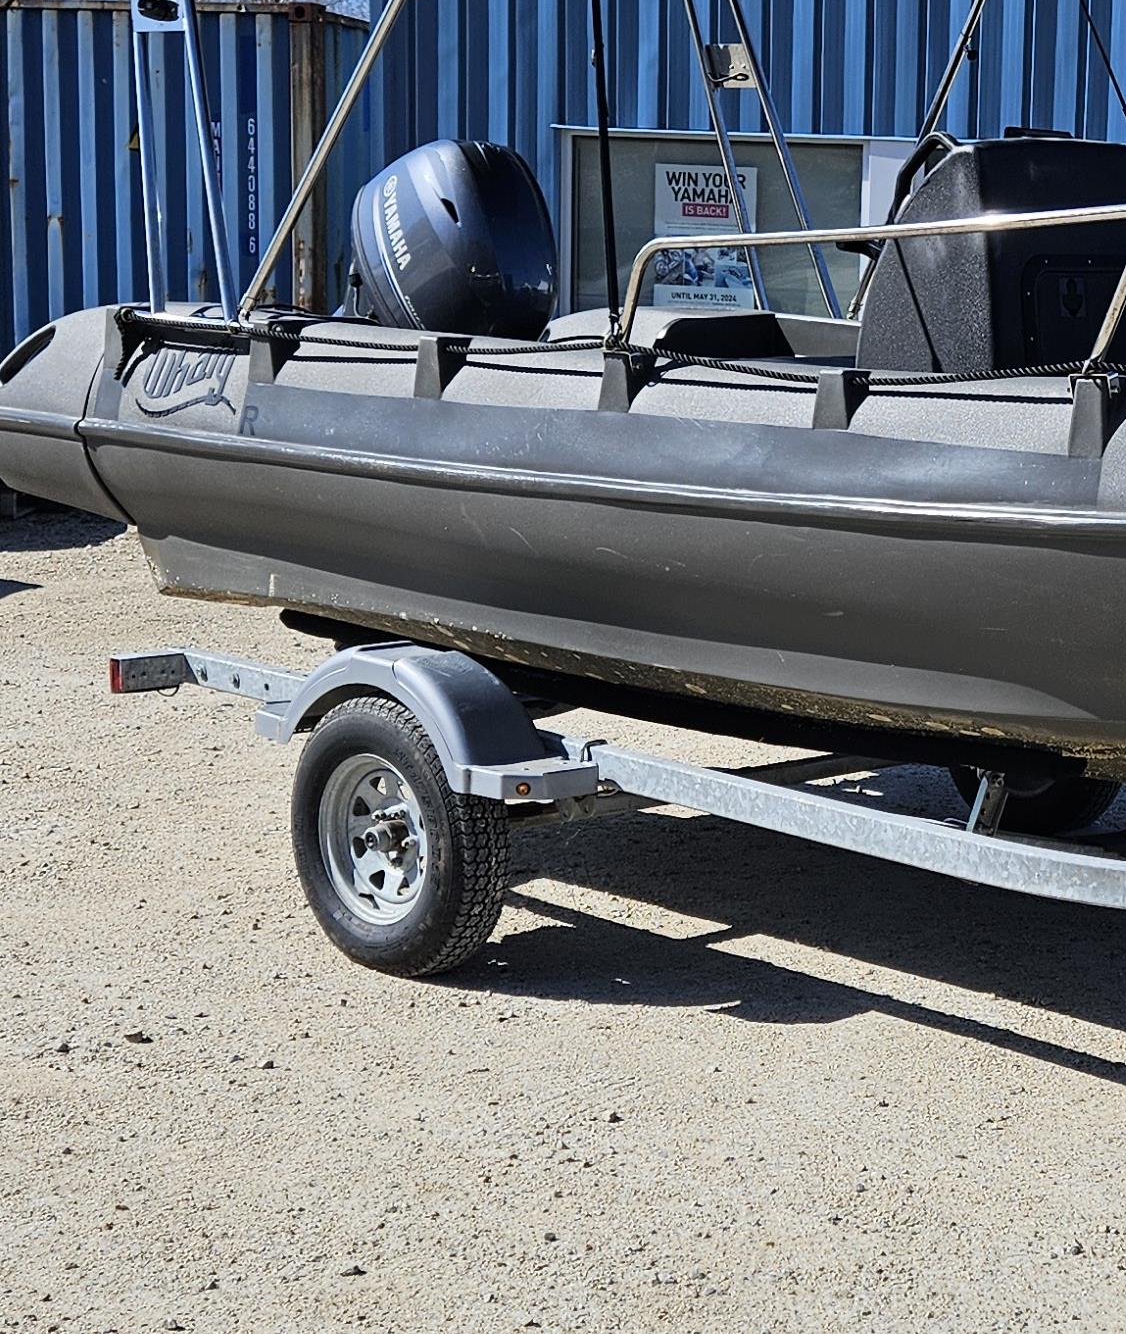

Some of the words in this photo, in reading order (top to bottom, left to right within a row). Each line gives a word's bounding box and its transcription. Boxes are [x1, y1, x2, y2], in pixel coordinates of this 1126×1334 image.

[247, 118, 255, 230] 644088
[666, 171, 698, 187] WIN
[671, 187, 733, 204] YAMAH
[685, 205, 694, 214] IS
[698, 206, 726, 216] BACK!
[383, 192, 411, 271] YAMAHA
[249, 236, 256, 253] 6
[671, 292, 692, 300] UNTIL
[694, 293, 709, 301] MAY
[710, 294, 719, 302] 31,
[721, 294, 737, 302] 2024
